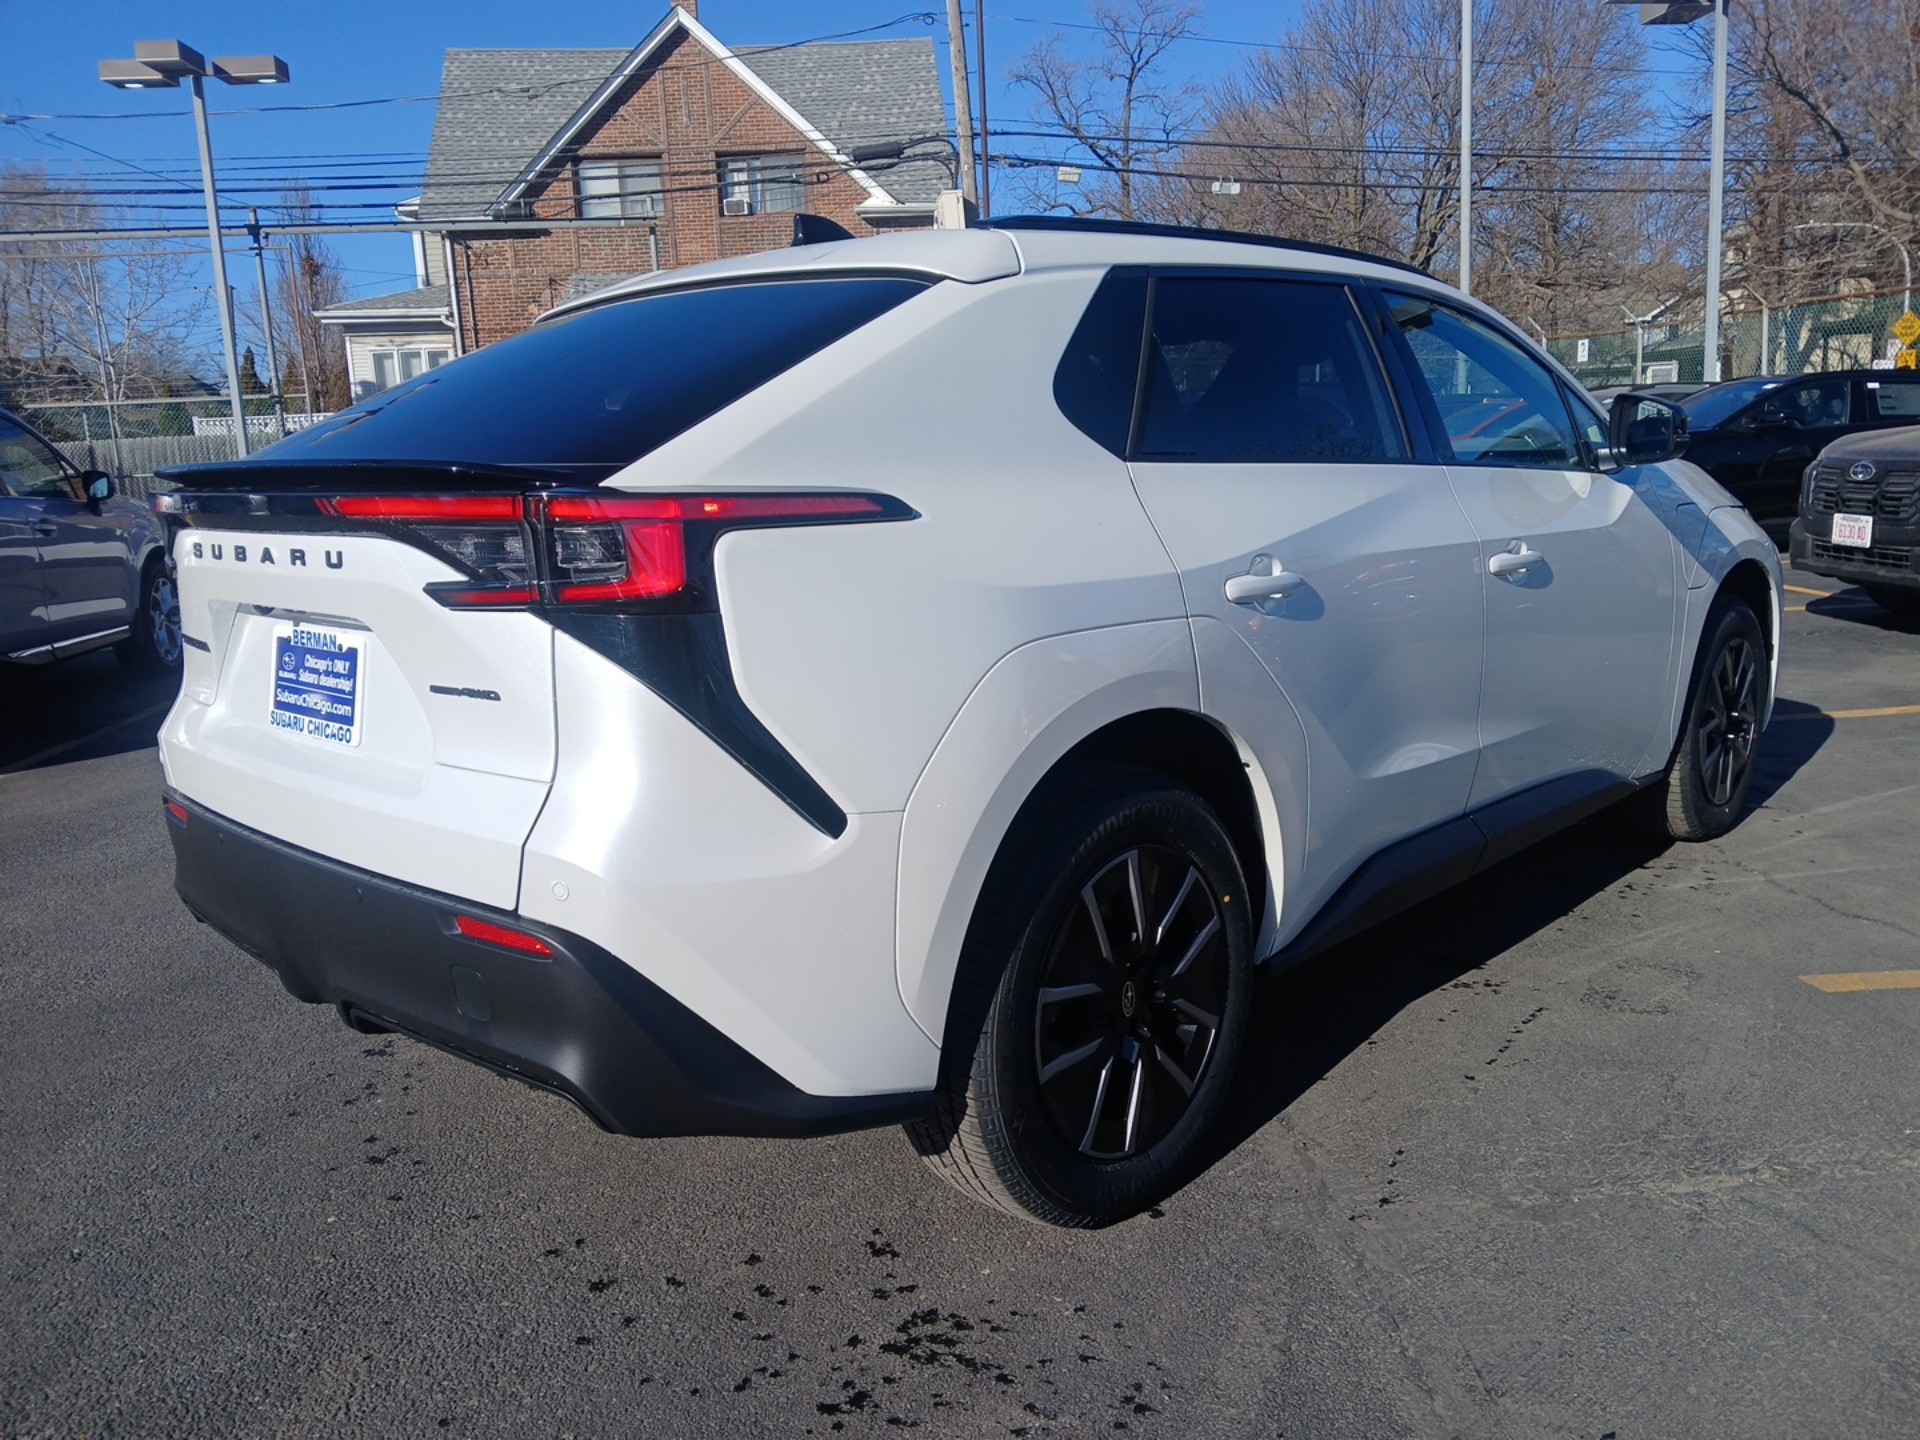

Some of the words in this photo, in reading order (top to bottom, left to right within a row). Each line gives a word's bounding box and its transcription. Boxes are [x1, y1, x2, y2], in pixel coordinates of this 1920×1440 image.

[192, 542, 344, 569] SUBARU
[292, 629, 337, 651] BERMAN
[304, 654, 333, 672] Chicago's
[333, 659, 350, 674] ONLY
[275, 688, 352, 716] SubaruChicago.com
[270, 710, 305, 732] SUBARU
[307, 719, 352, 743] CHICAGO
